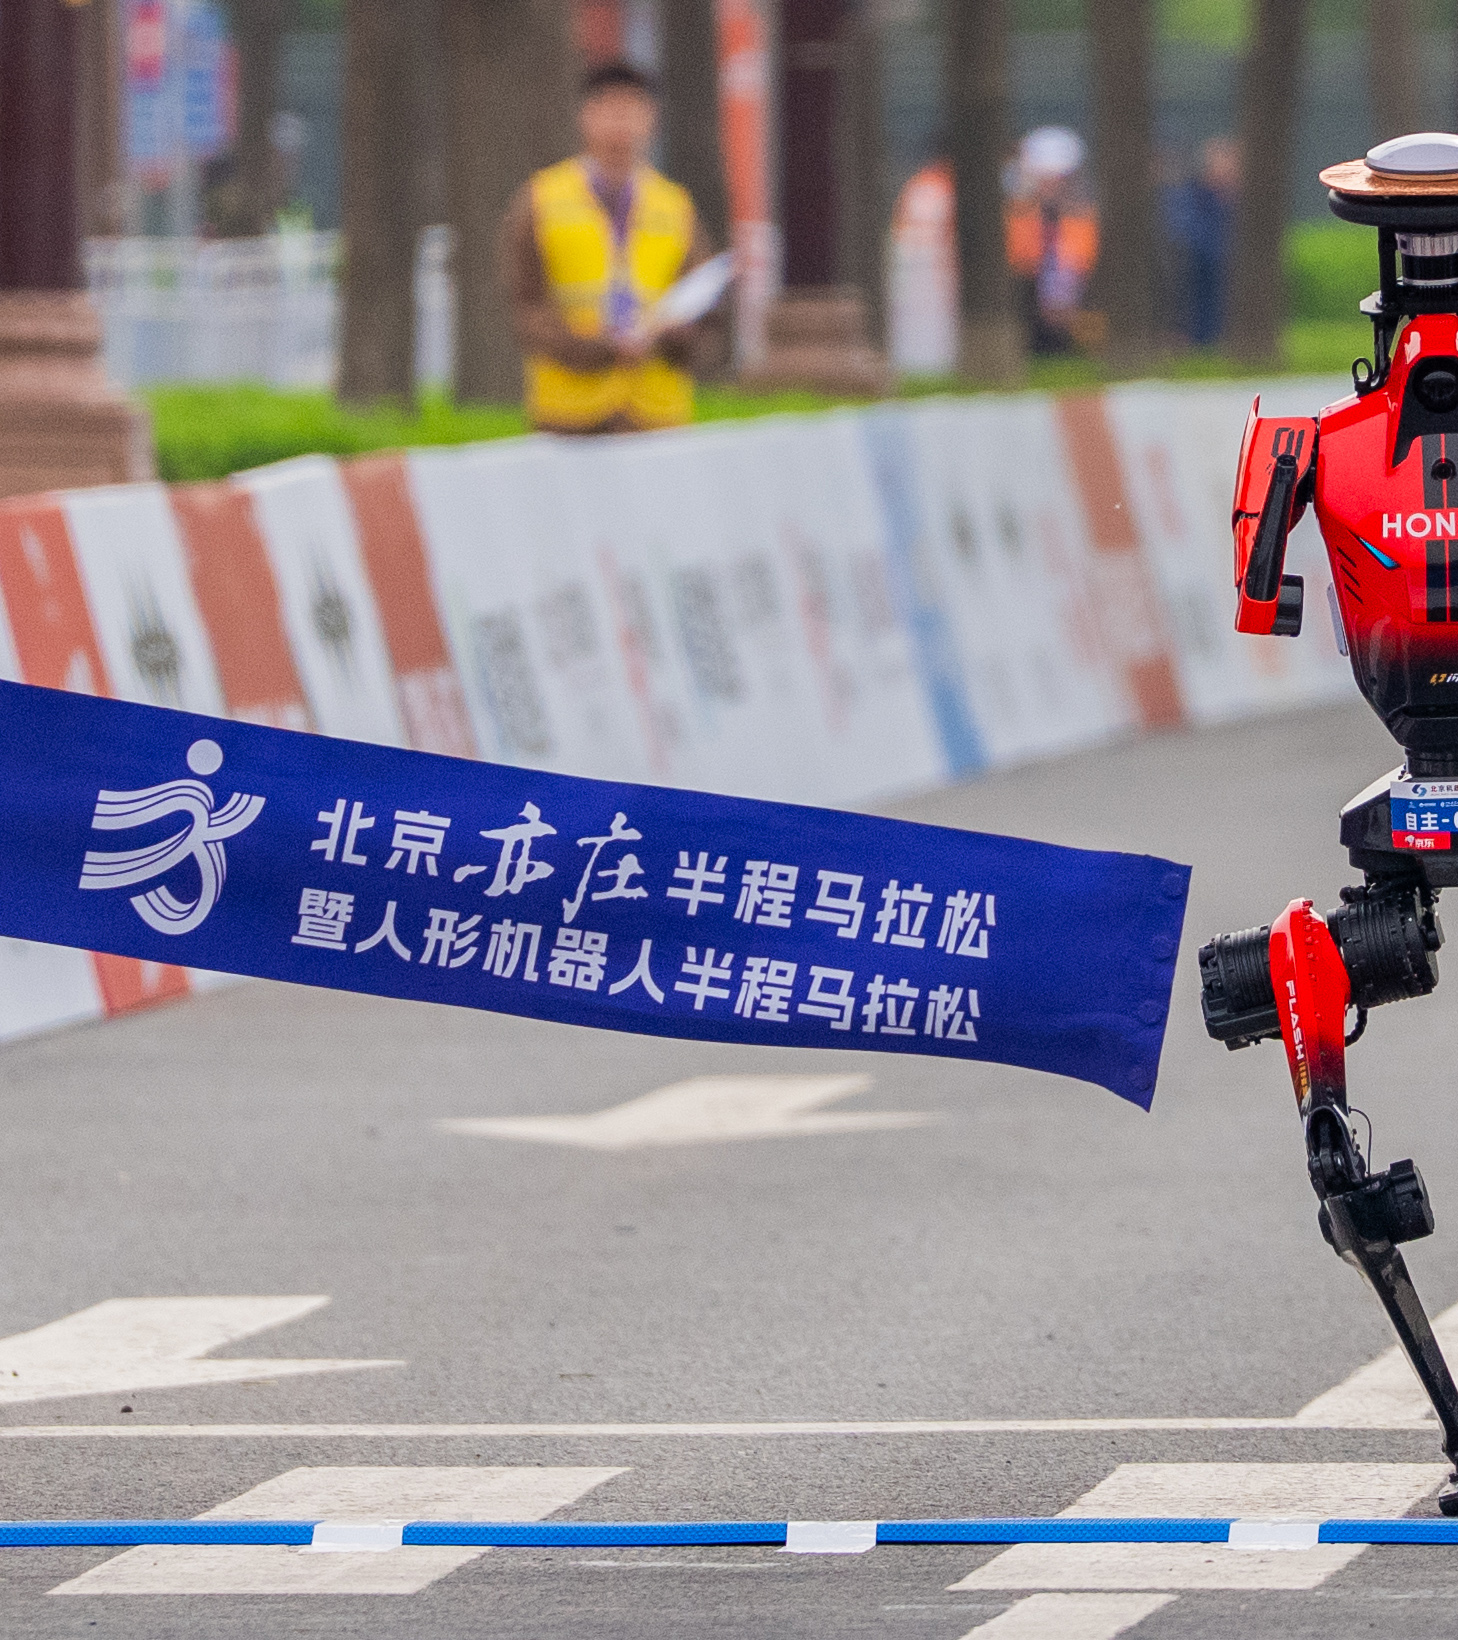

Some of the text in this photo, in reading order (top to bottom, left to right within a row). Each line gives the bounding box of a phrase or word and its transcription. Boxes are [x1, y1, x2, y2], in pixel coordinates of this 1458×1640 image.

[310, 798, 998, 959] 北京亦庄半程马拉松
[291, 887, 982, 1042] 暨人形机器人半程马拉松
[1285, 979, 1305, 1061] FLASH
